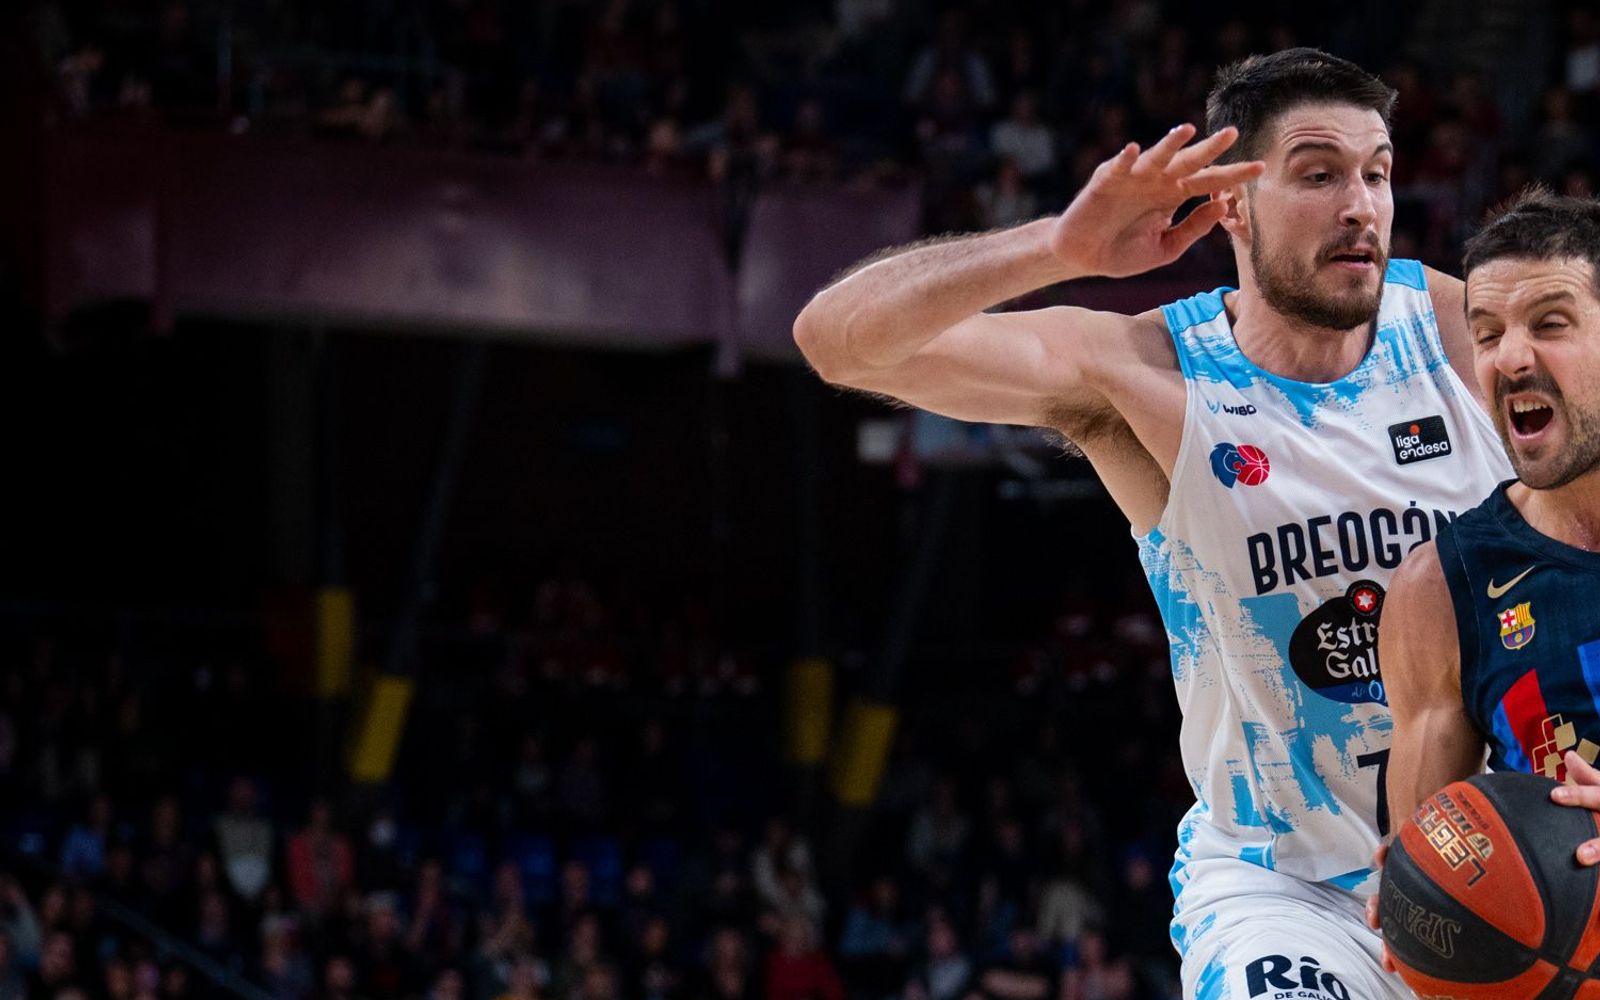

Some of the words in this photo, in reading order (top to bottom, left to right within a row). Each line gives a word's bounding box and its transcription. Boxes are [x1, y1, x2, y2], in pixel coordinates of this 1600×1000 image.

[1222, 404, 1257, 416] WIBO
[1396, 434, 1420, 449] liga
[1400, 441, 1449, 460] endesa
[1274, 991, 1294, 1000] DE
